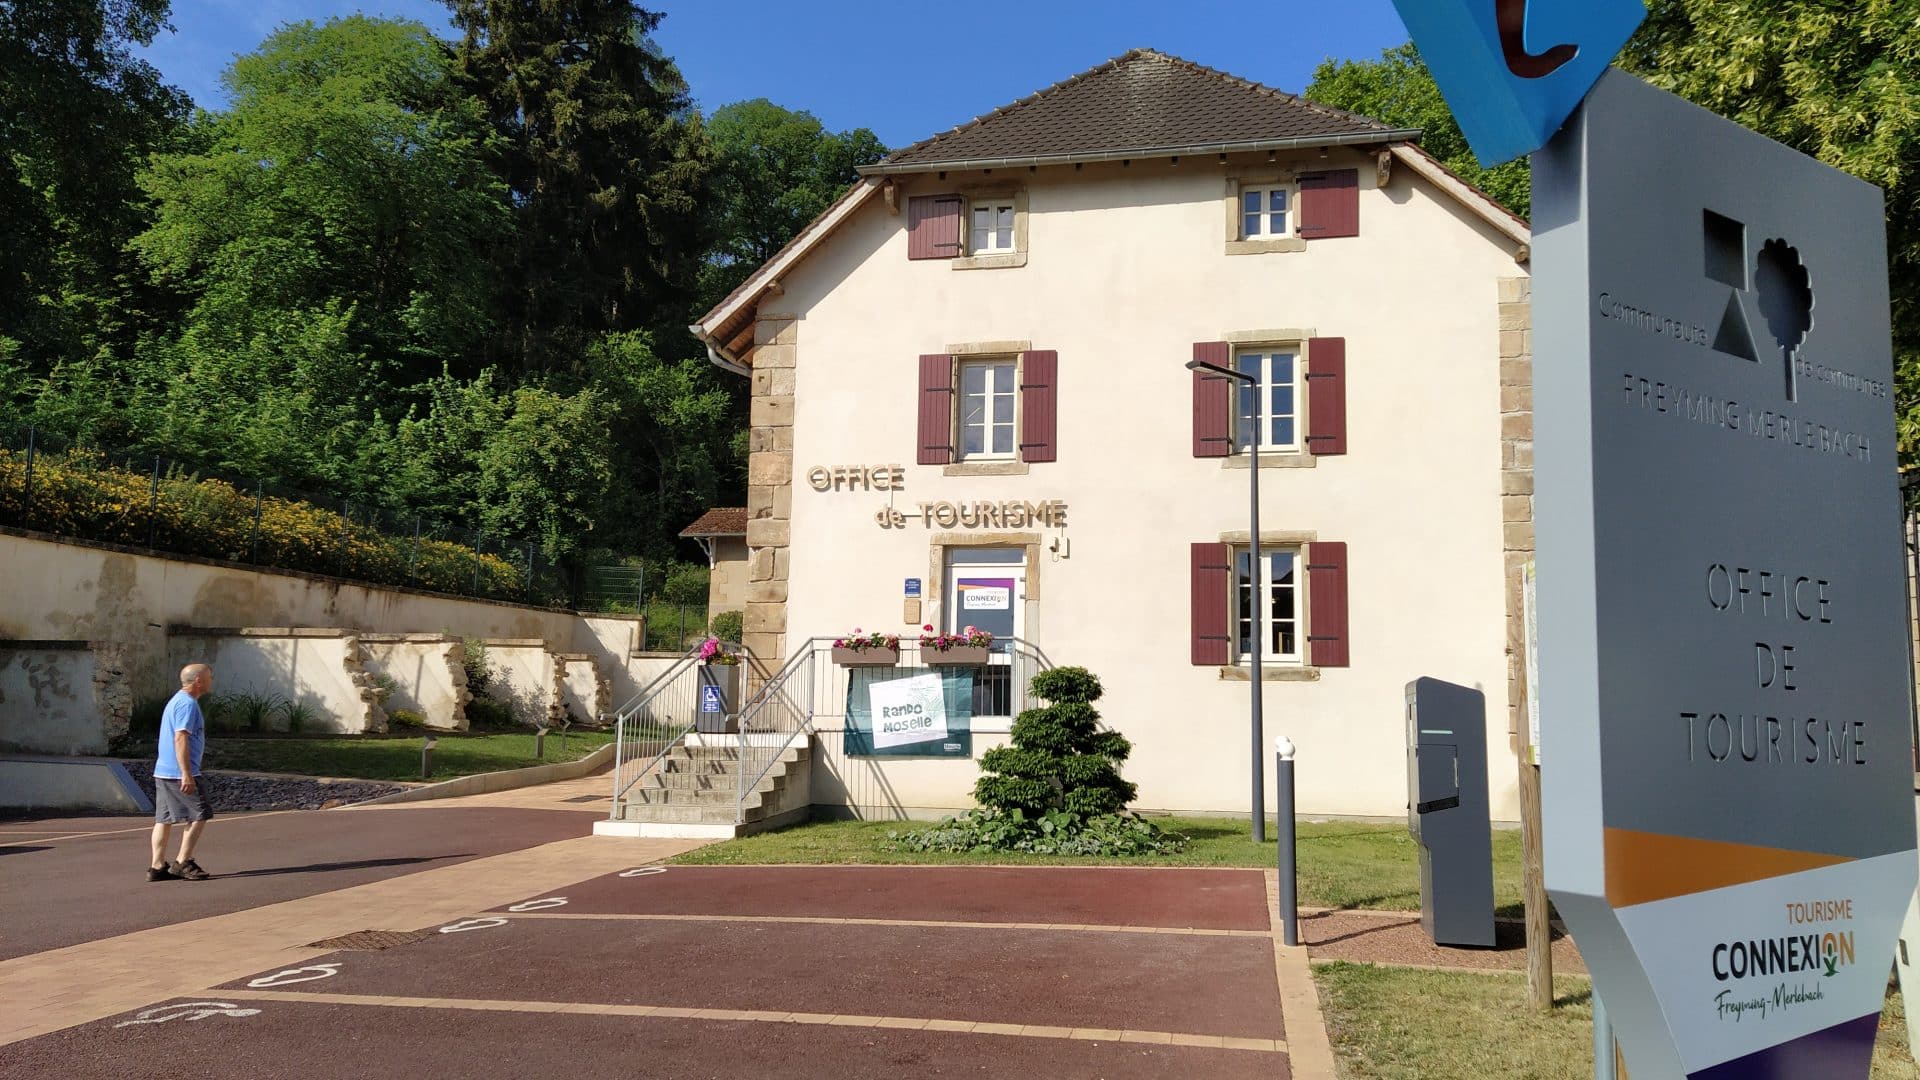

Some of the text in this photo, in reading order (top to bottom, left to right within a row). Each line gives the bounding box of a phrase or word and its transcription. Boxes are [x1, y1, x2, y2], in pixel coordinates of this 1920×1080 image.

[1796, 353, 1886, 398] de communes
[1624, 374, 1872, 463] FREYMING MERLEBACH
[807, 464, 904, 491] OFFICE
[874, 499, 1068, 529] de TOURISME
[1708, 563, 1832, 624] OFFICE
[1755, 642, 1798, 691] DE
[1681, 713, 1867, 765] TOURISME
[1786, 899, 1853, 925] TOURISME
[1712, 931, 1855, 981] CONNEXION
